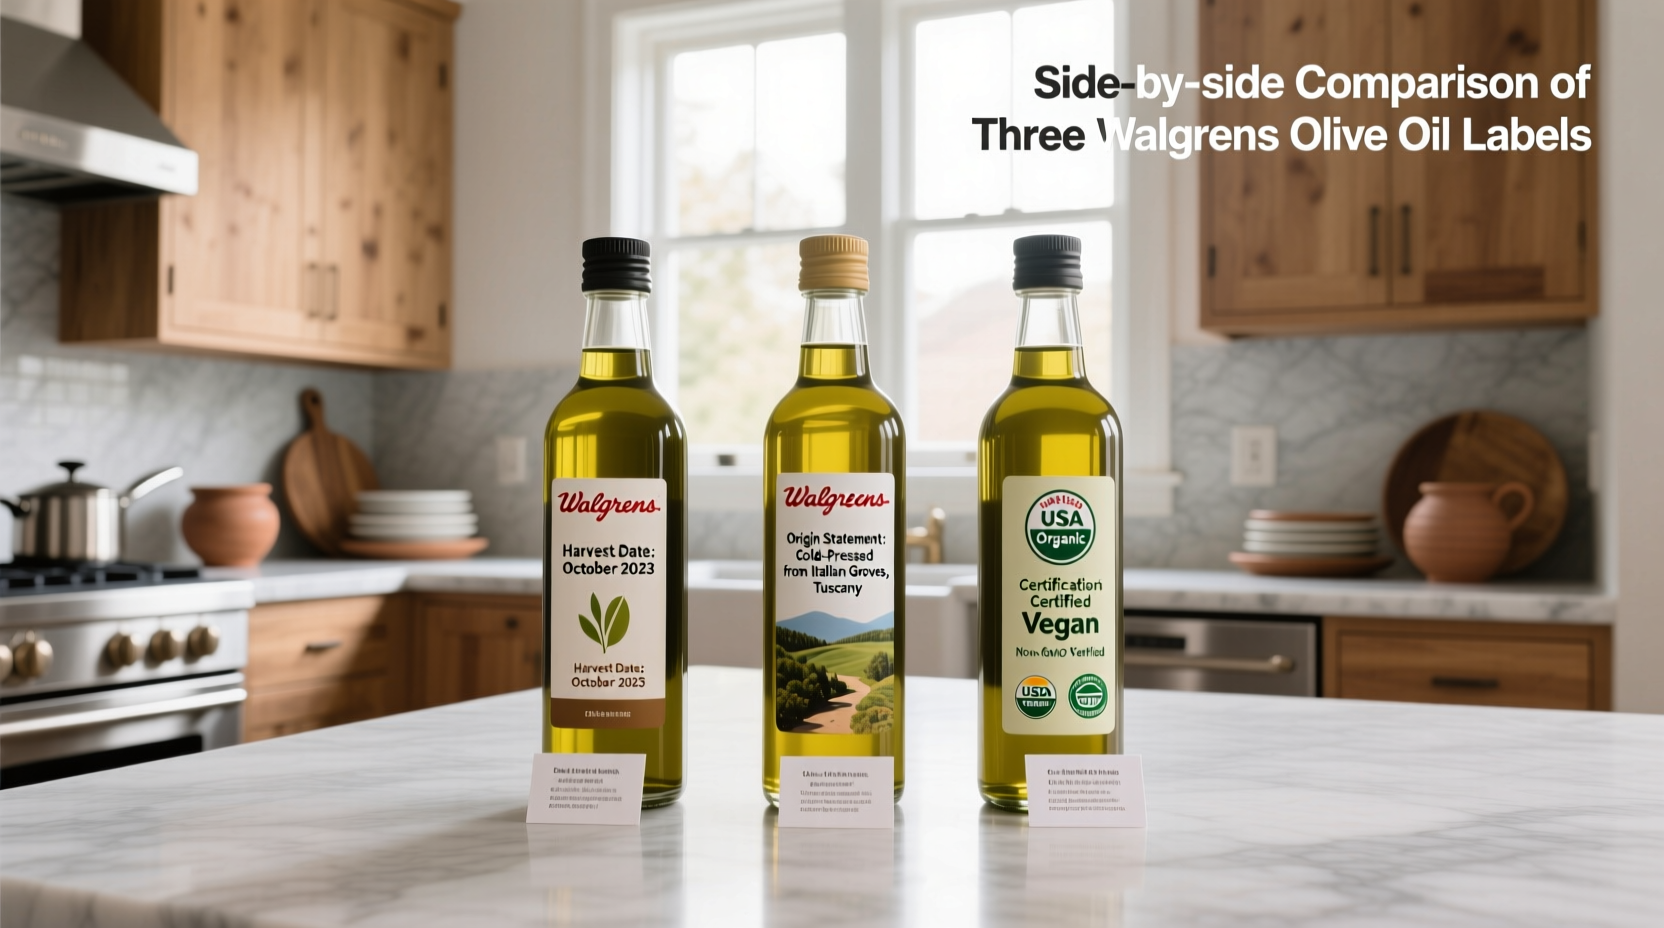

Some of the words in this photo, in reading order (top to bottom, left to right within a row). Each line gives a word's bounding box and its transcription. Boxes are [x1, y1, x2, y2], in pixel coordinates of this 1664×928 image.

[557, 490, 661, 522] Walgrens
[1041, 509, 1084, 527] USA
[786, 531, 820, 548] Origin
[822, 532, 886, 545] Statement:
[1036, 531, 1086, 549] Organic
[562, 543, 616, 558] Harvest
[618, 543, 655, 558] Date:
[562, 560, 618, 575] October
[620, 561, 655, 575] 2023
[783, 564, 808, 577] from
[848, 564, 890, 579] Groves,
[813, 581, 863, 597] Tuscany
[1019, 577, 1103, 591] Certification
[1030, 594, 1091, 608] Certified
[1021, 611, 1099, 641] Vegan
